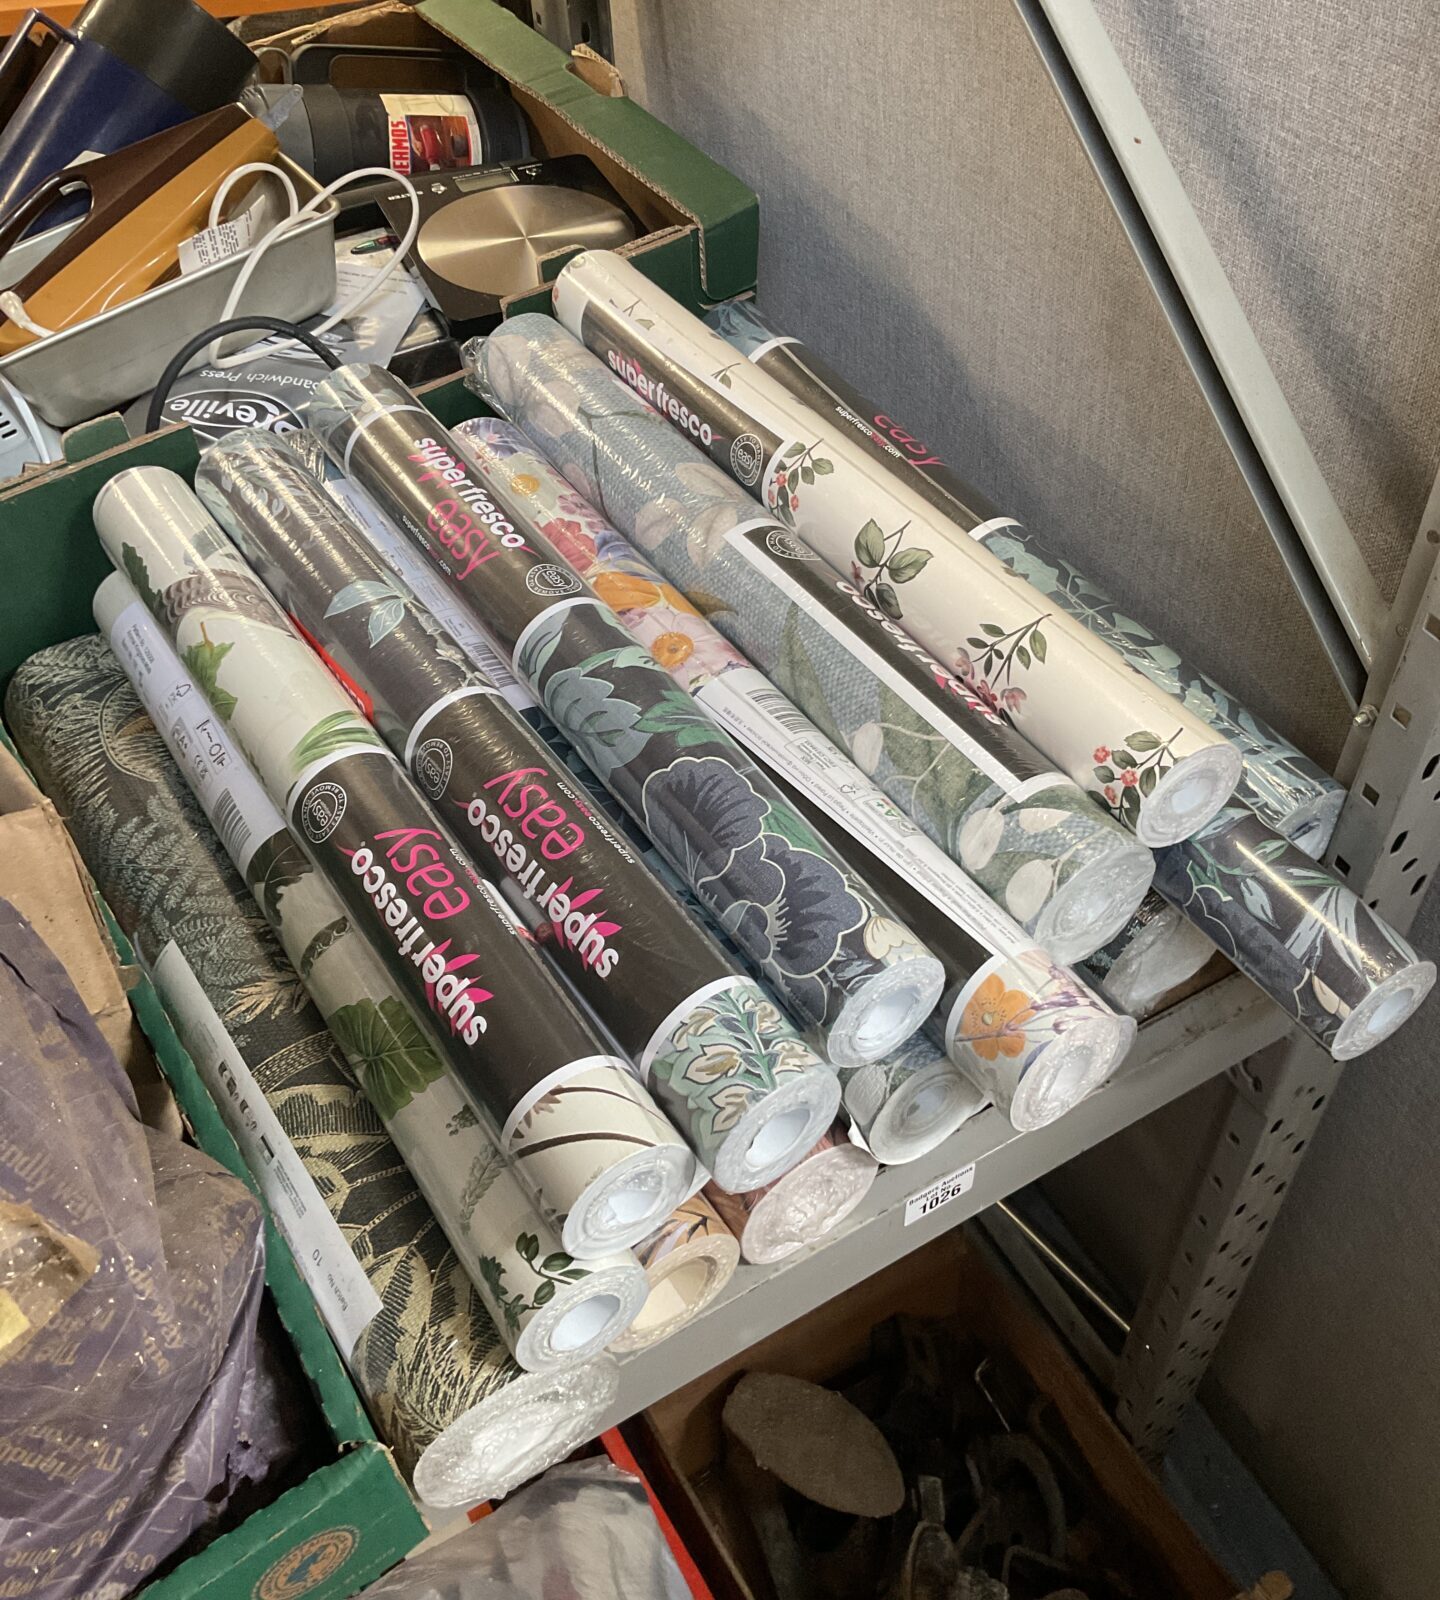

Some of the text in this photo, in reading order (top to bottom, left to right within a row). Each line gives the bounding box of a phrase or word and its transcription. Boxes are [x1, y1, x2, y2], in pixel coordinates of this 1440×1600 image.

[391, 120, 411, 176] ERMOS
[200, 369, 243, 382] Press
[607, 350, 713, 446] superfresco
[414, 437, 525, 548] superfresco
[427, 499, 500, 581] easy
[546, 570, 568, 587] easy
[308, 799, 329, 827] easy
[483, 767, 585, 860] easy
[373, 828, 471, 920] easy
[467, 799, 619, 978] superfresco
[351, 848, 487, 1046] superfresco
[908, 1166, 973, 1206] Badgers Auctions
[920, 1184, 962, 1214] 1026
[312, 1249, 323, 1267] 10
